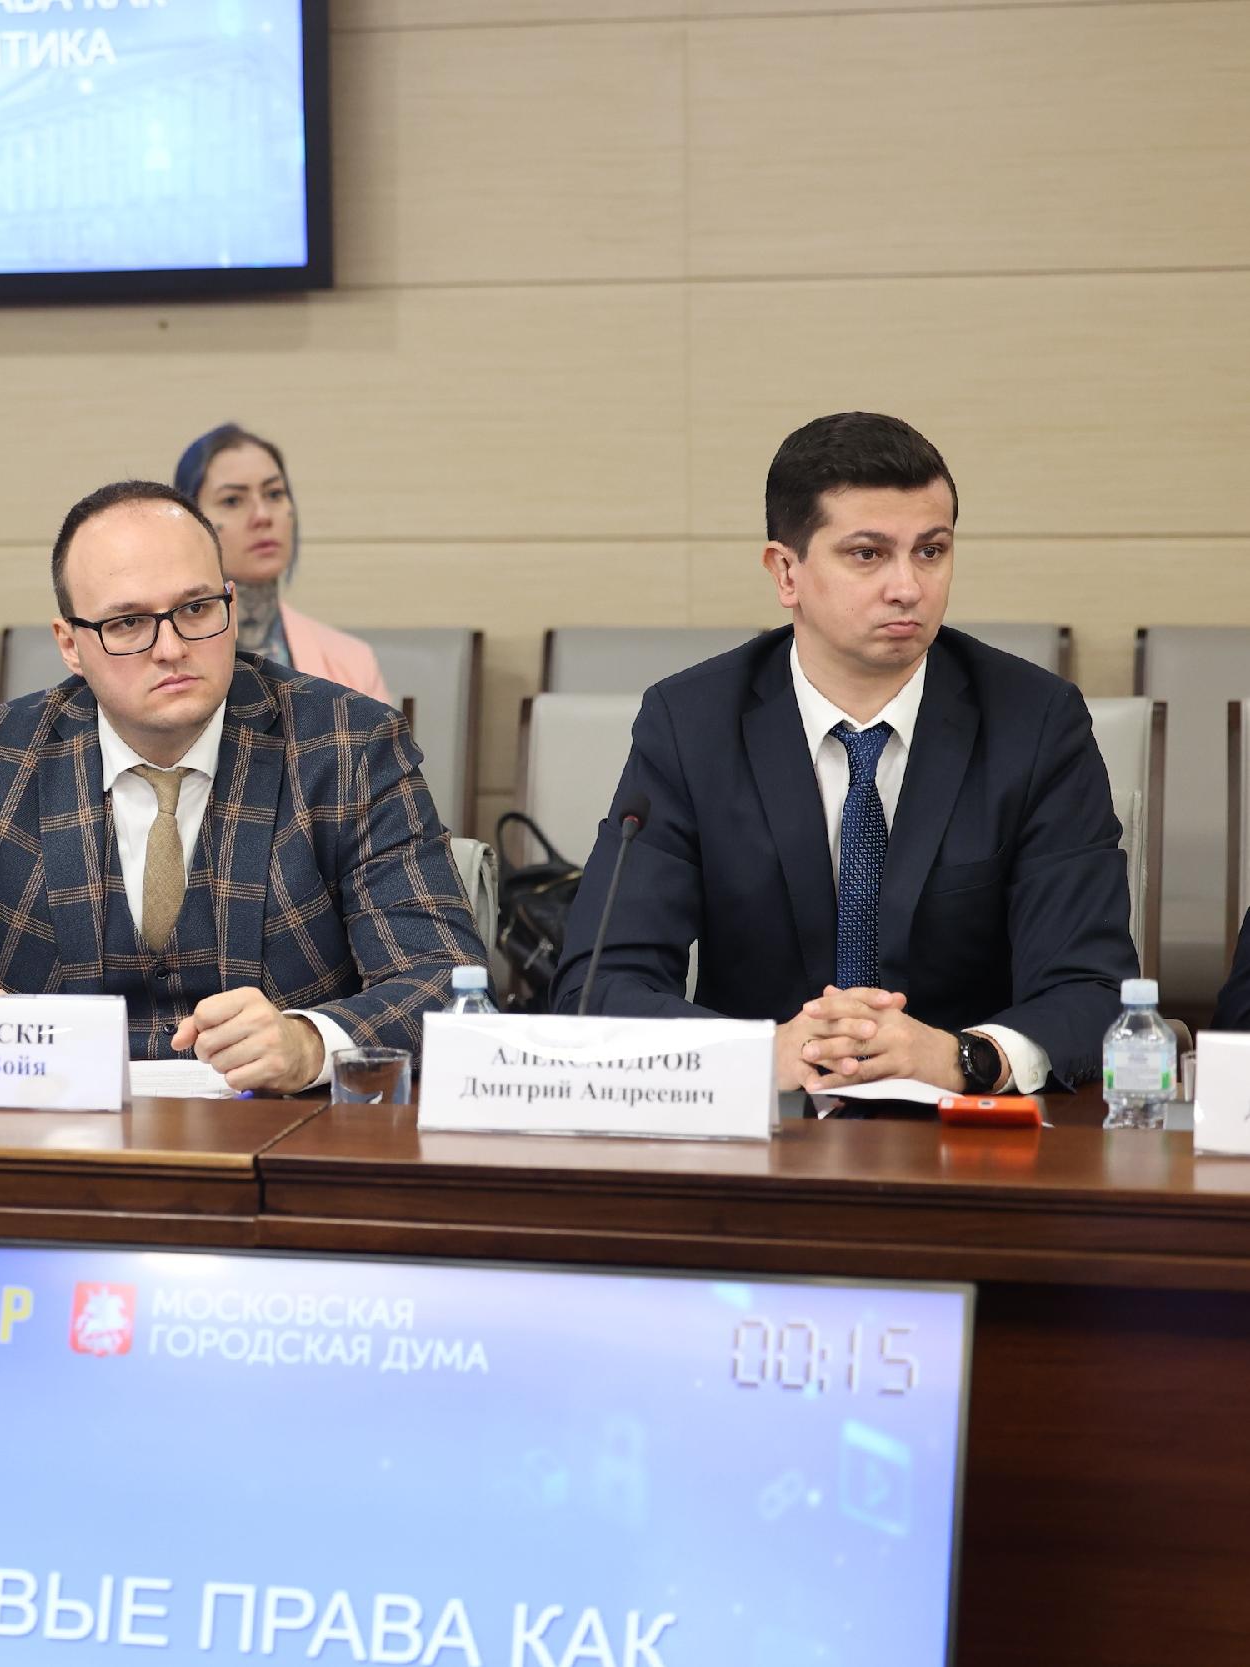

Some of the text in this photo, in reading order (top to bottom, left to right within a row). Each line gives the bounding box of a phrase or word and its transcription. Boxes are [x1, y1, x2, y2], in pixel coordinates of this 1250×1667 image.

[458, 1076, 715, 1107] Дмитрий Андреевич
[150, 1287, 416, 1330] МОСКОВСКАЯ
[146, 1321, 491, 1375] ГОРОДСКАЯ ДУМА
[732, 1316, 921, 1396] 00:15
[197, 1580, 484, 1667] ПРАВА
[511, 1602, 678, 1667] КАК
